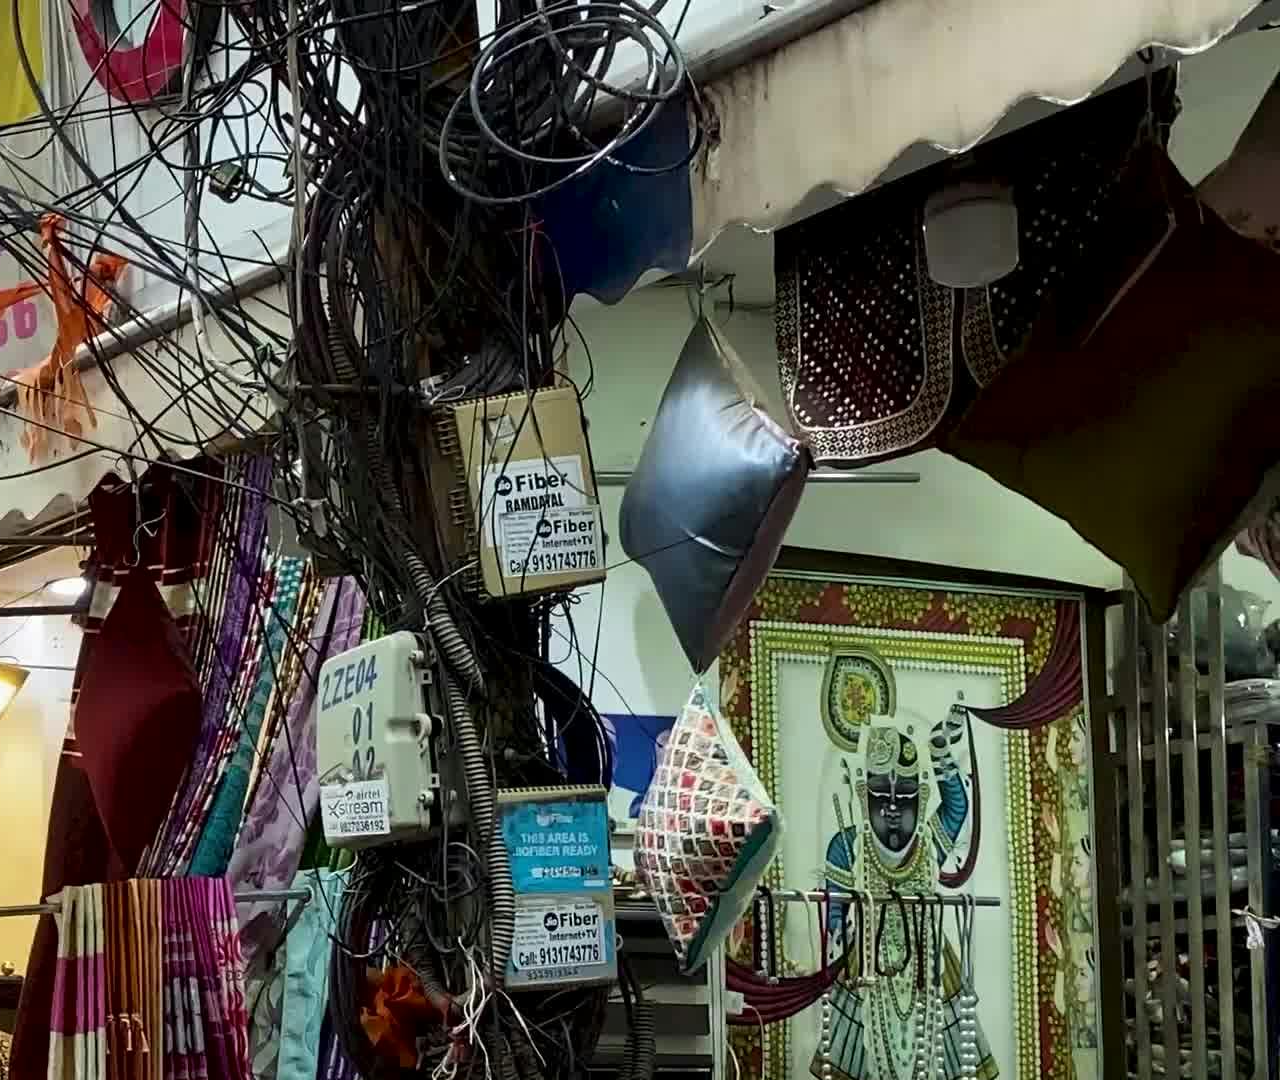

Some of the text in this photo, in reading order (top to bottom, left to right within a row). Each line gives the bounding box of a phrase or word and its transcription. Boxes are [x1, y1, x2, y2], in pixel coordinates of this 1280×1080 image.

[515, 472, 568, 492] Fiber
[506, 492, 565, 513] RAMDAYAL
[553, 519, 594, 534] Fiber
[532, 550, 596, 573] 9131743776
[352, 701, 374, 745] 01
[548, 833, 575, 844] AREA
[578, 833, 589, 843] IS
[563, 845, 598, 857] READY
[559, 913, 599, 927] Fiber
[549, 930, 597, 944] Internet+TV
[518, 944, 599, 966] Call: 9131743776
